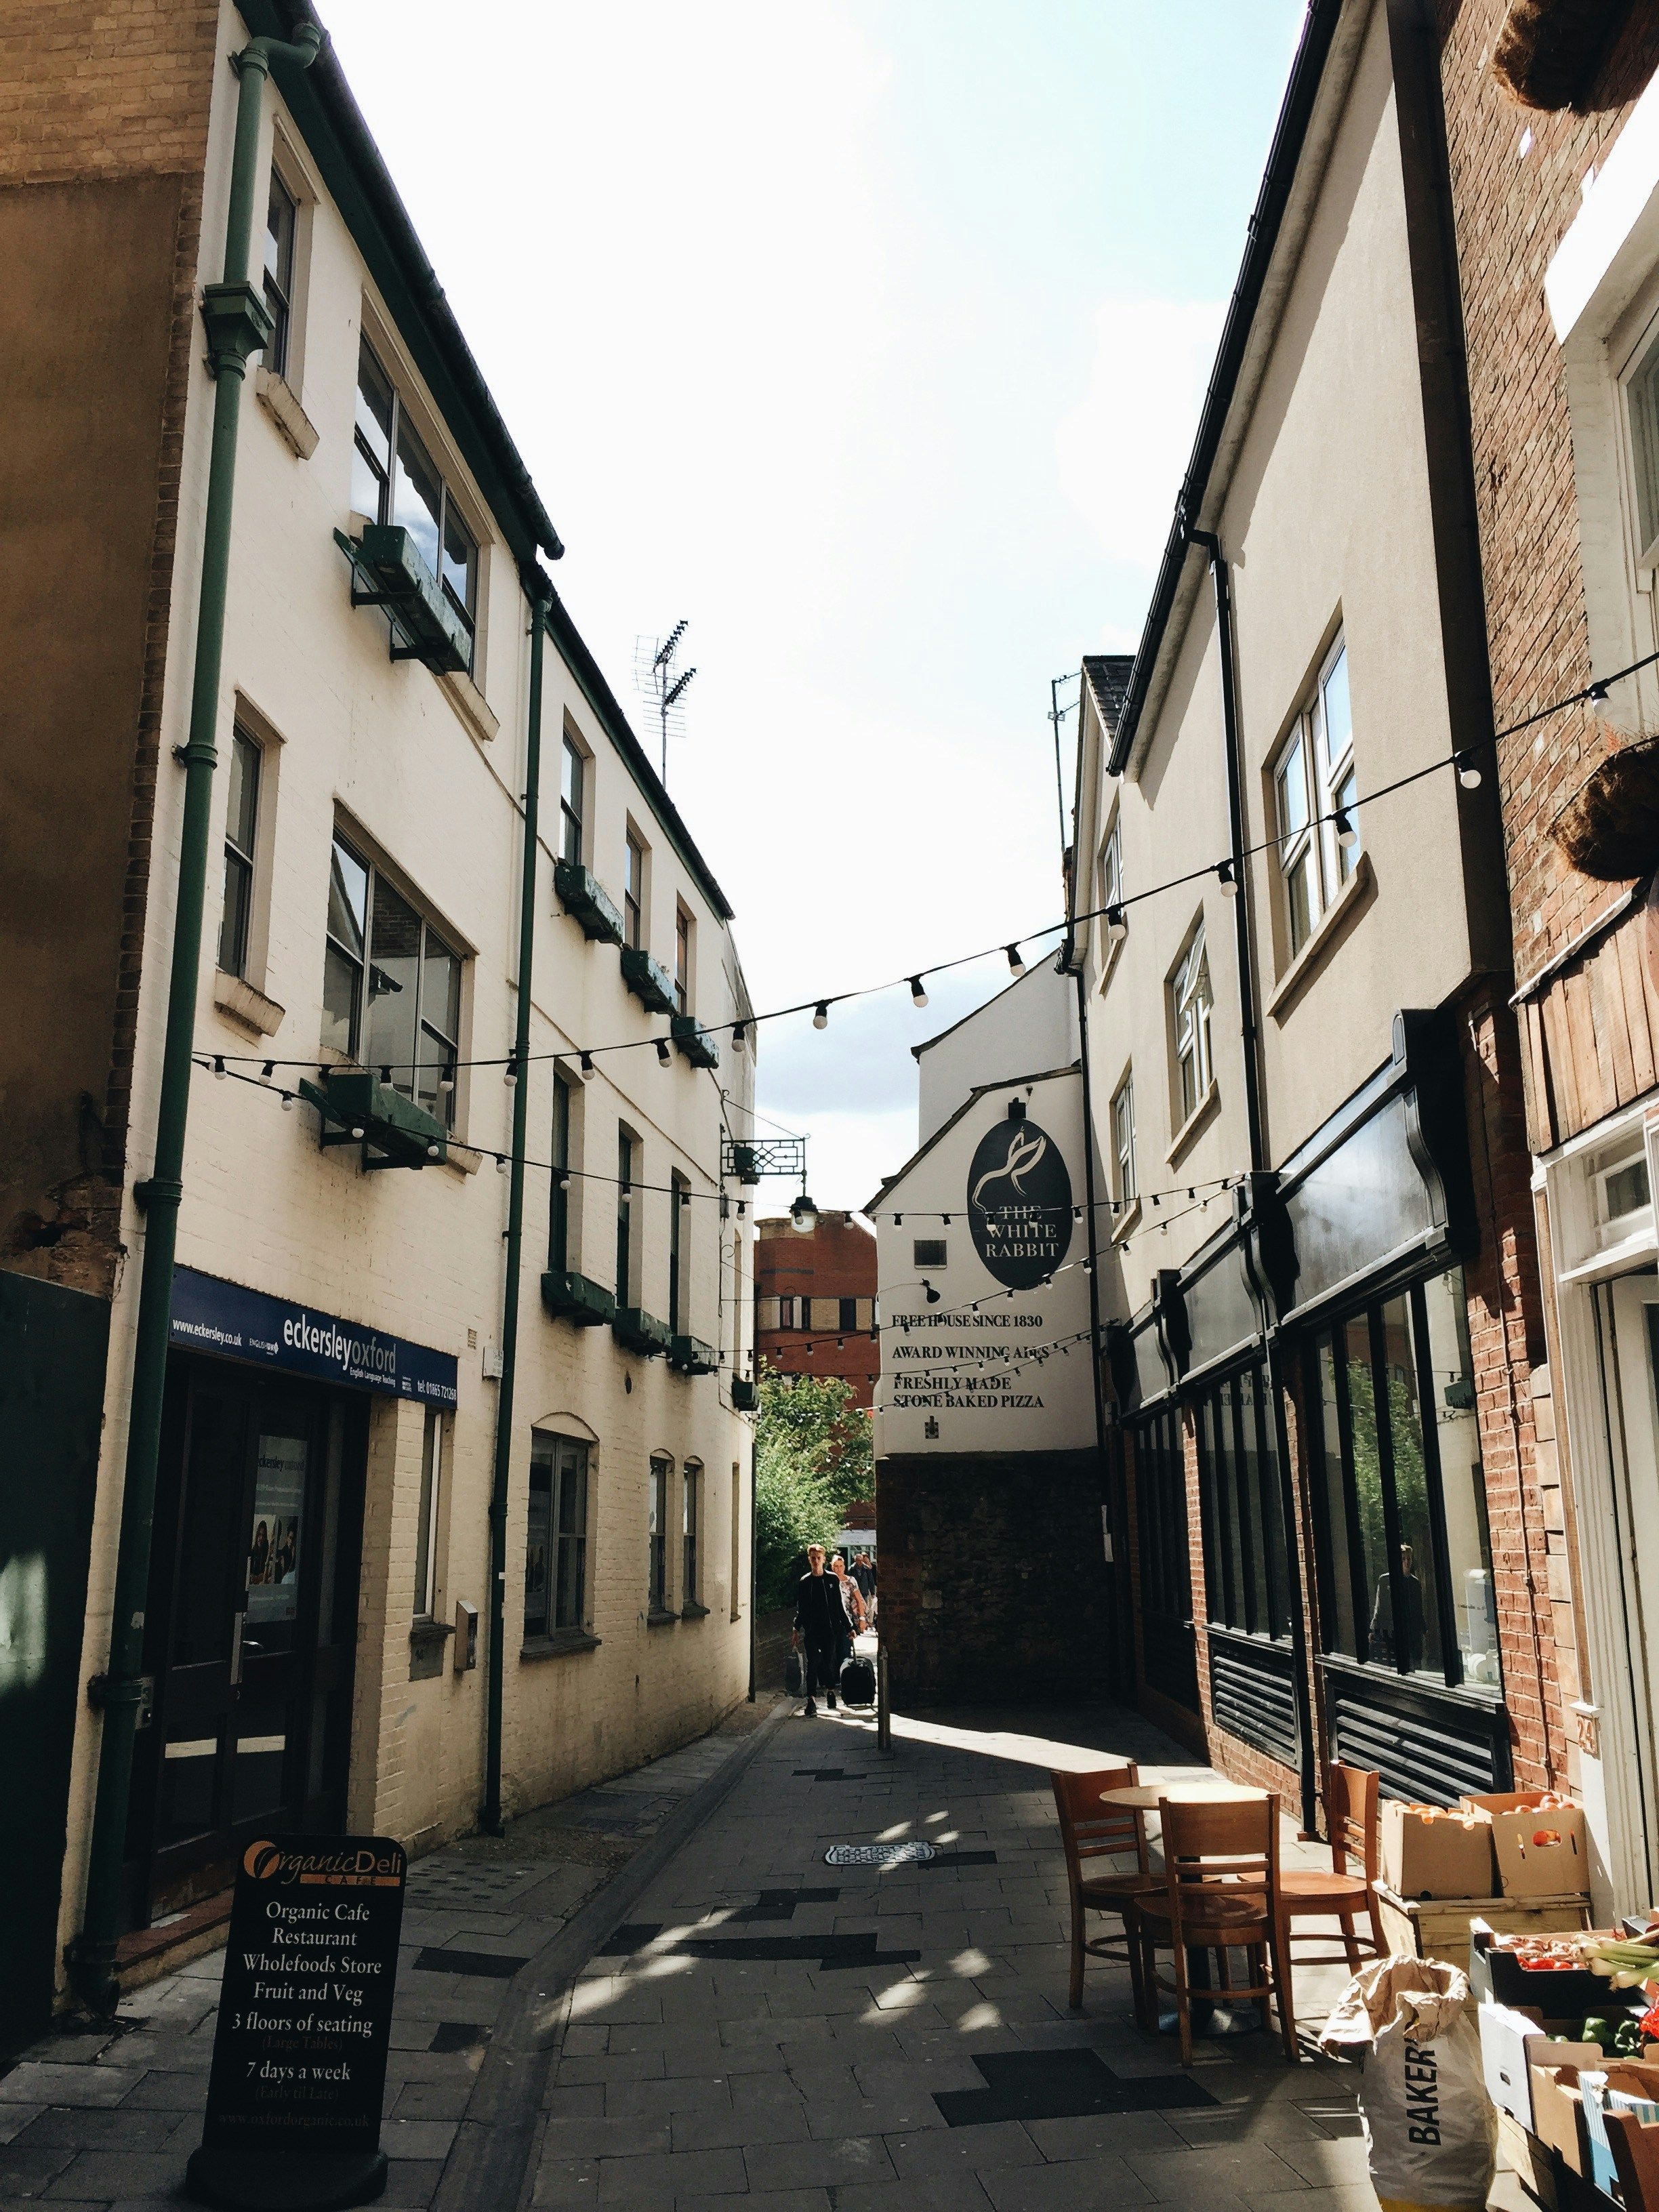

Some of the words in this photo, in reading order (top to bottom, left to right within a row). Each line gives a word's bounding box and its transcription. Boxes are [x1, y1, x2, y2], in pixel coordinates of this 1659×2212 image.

[985, 1224, 1057, 1238] WHITE
[985, 1243, 1059, 1258] RABBIT
[892, 1315, 926, 1327] FREE
[928, 1315, 970, 1327] HOUSE
[972, 1315, 1010, 1327] SINCE
[1013, 1315, 1043, 1327] 1830
[172, 1318, 242, 1347] www.eckersley.co.uk
[892, 1346, 943, 1359] AWARD
[944, 1346, 1010, 1359] WINNING
[1013, 1346, 1050, 1359] ALES
[893, 1376, 963, 1389] FRESHLY
[965, 1376, 1012, 1389] MADE
[893, 1394, 943, 1408] STONE
[945, 1394, 998, 1408] BAKED
[1000, 1395, 1044, 1408] PIZZA
[325, 1876, 376, 1886] CAFE
[266, 1901, 330, 1924] Organic
[335, 1903, 370, 1921] Cafe
[272, 1927, 358, 1946] Restaurant
[243, 1953, 336, 1973] Wholefoods
[340, 1956, 382, 1974] Store
[253, 1982, 295, 1999] Fruit
[298, 1982, 328, 2000] and
[333, 1984, 364, 2007] Veg
[232, 2013, 241, 2029] 3
[246, 2011, 292, 2030] floors
[296, 2013, 314, 2031] of
[316, 2015, 373, 2039] seating
[246, 2062, 257, 2078] 7
[260, 2060, 294, 2084] days
[298, 2067, 307, 2079] a
[312, 2062, 351, 2081] week
